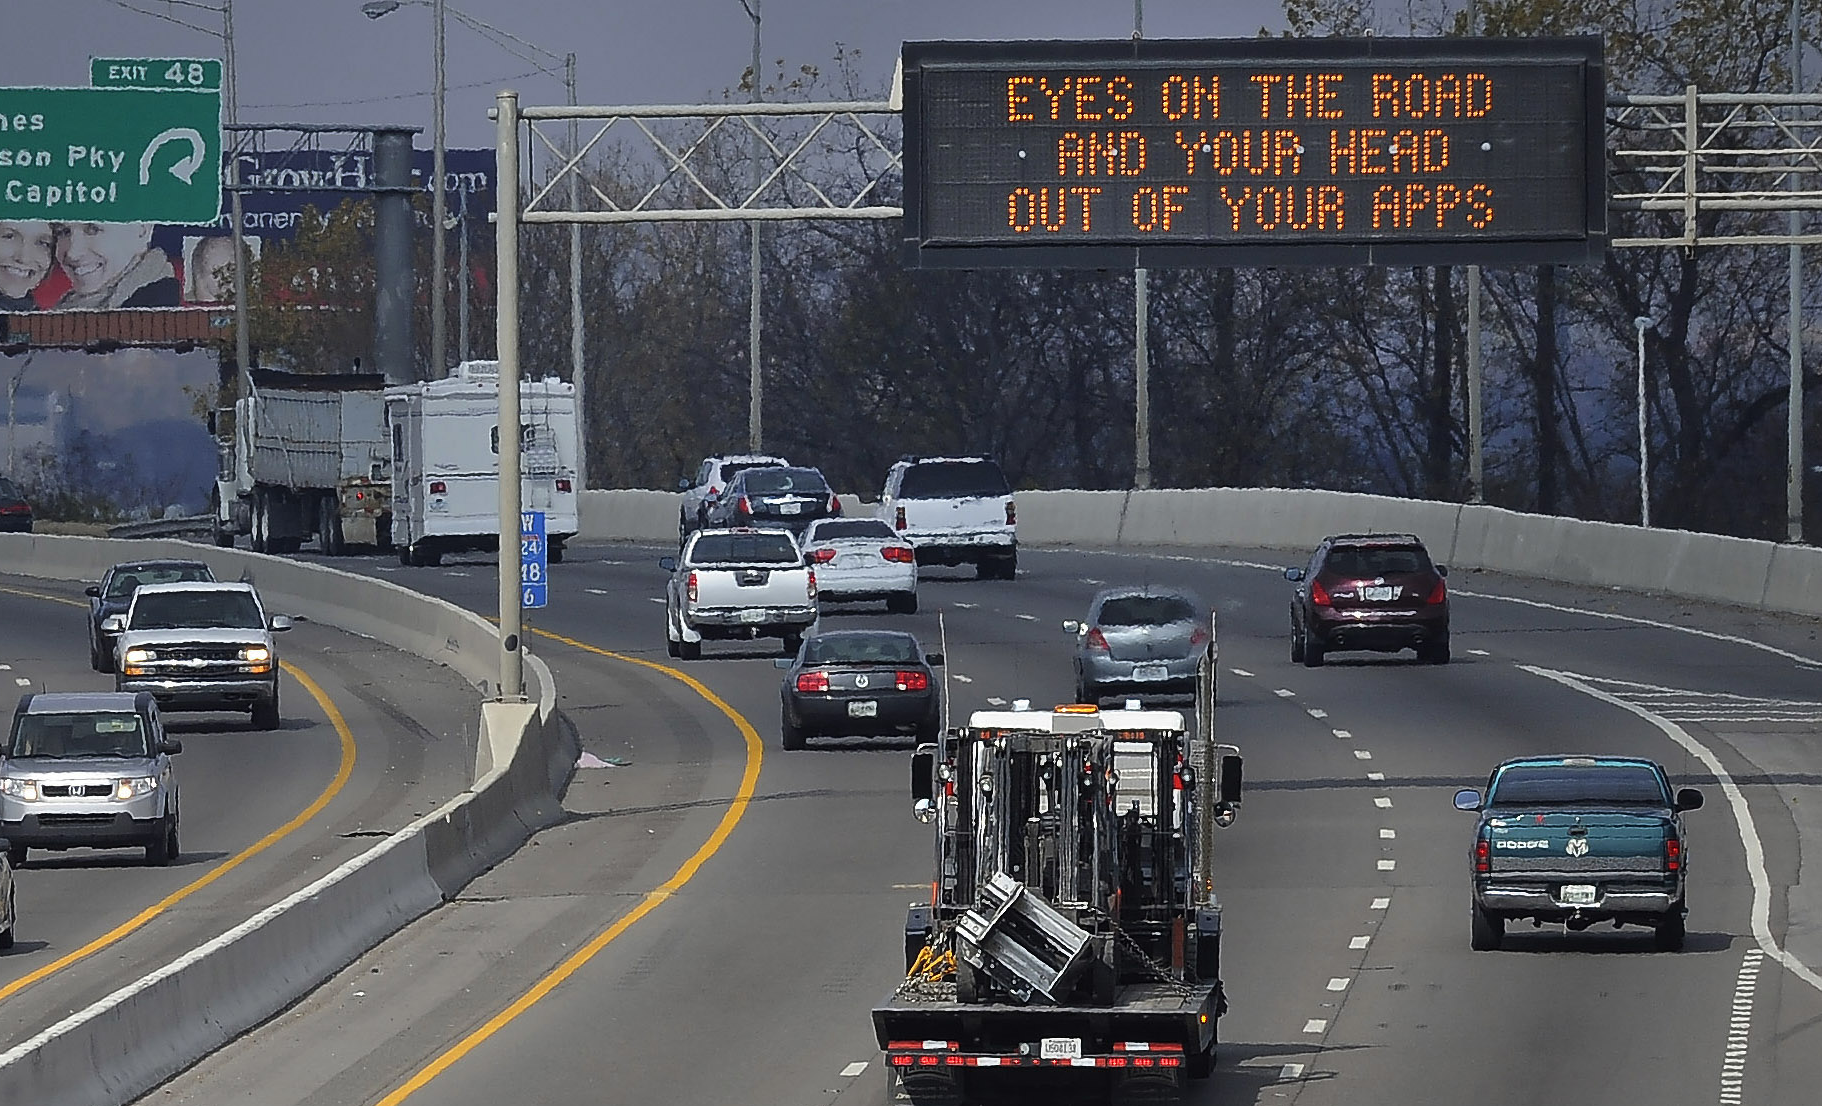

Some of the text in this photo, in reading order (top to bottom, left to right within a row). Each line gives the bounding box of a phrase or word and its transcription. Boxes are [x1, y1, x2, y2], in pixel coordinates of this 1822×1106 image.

[108, 62, 205, 86] EXIT 48
[1007, 73, 1492, 121] EYES ON THE ROAD
[68, 144, 126, 173] Pky
[1058, 129, 1449, 176] AND YOUR HEAD
[5, 179, 117, 207] Capitol
[1008, 183, 1494, 231] OUT OF YOUR APPS
[521, 540, 539, 556] 24
[523, 588, 535, 606] 6
